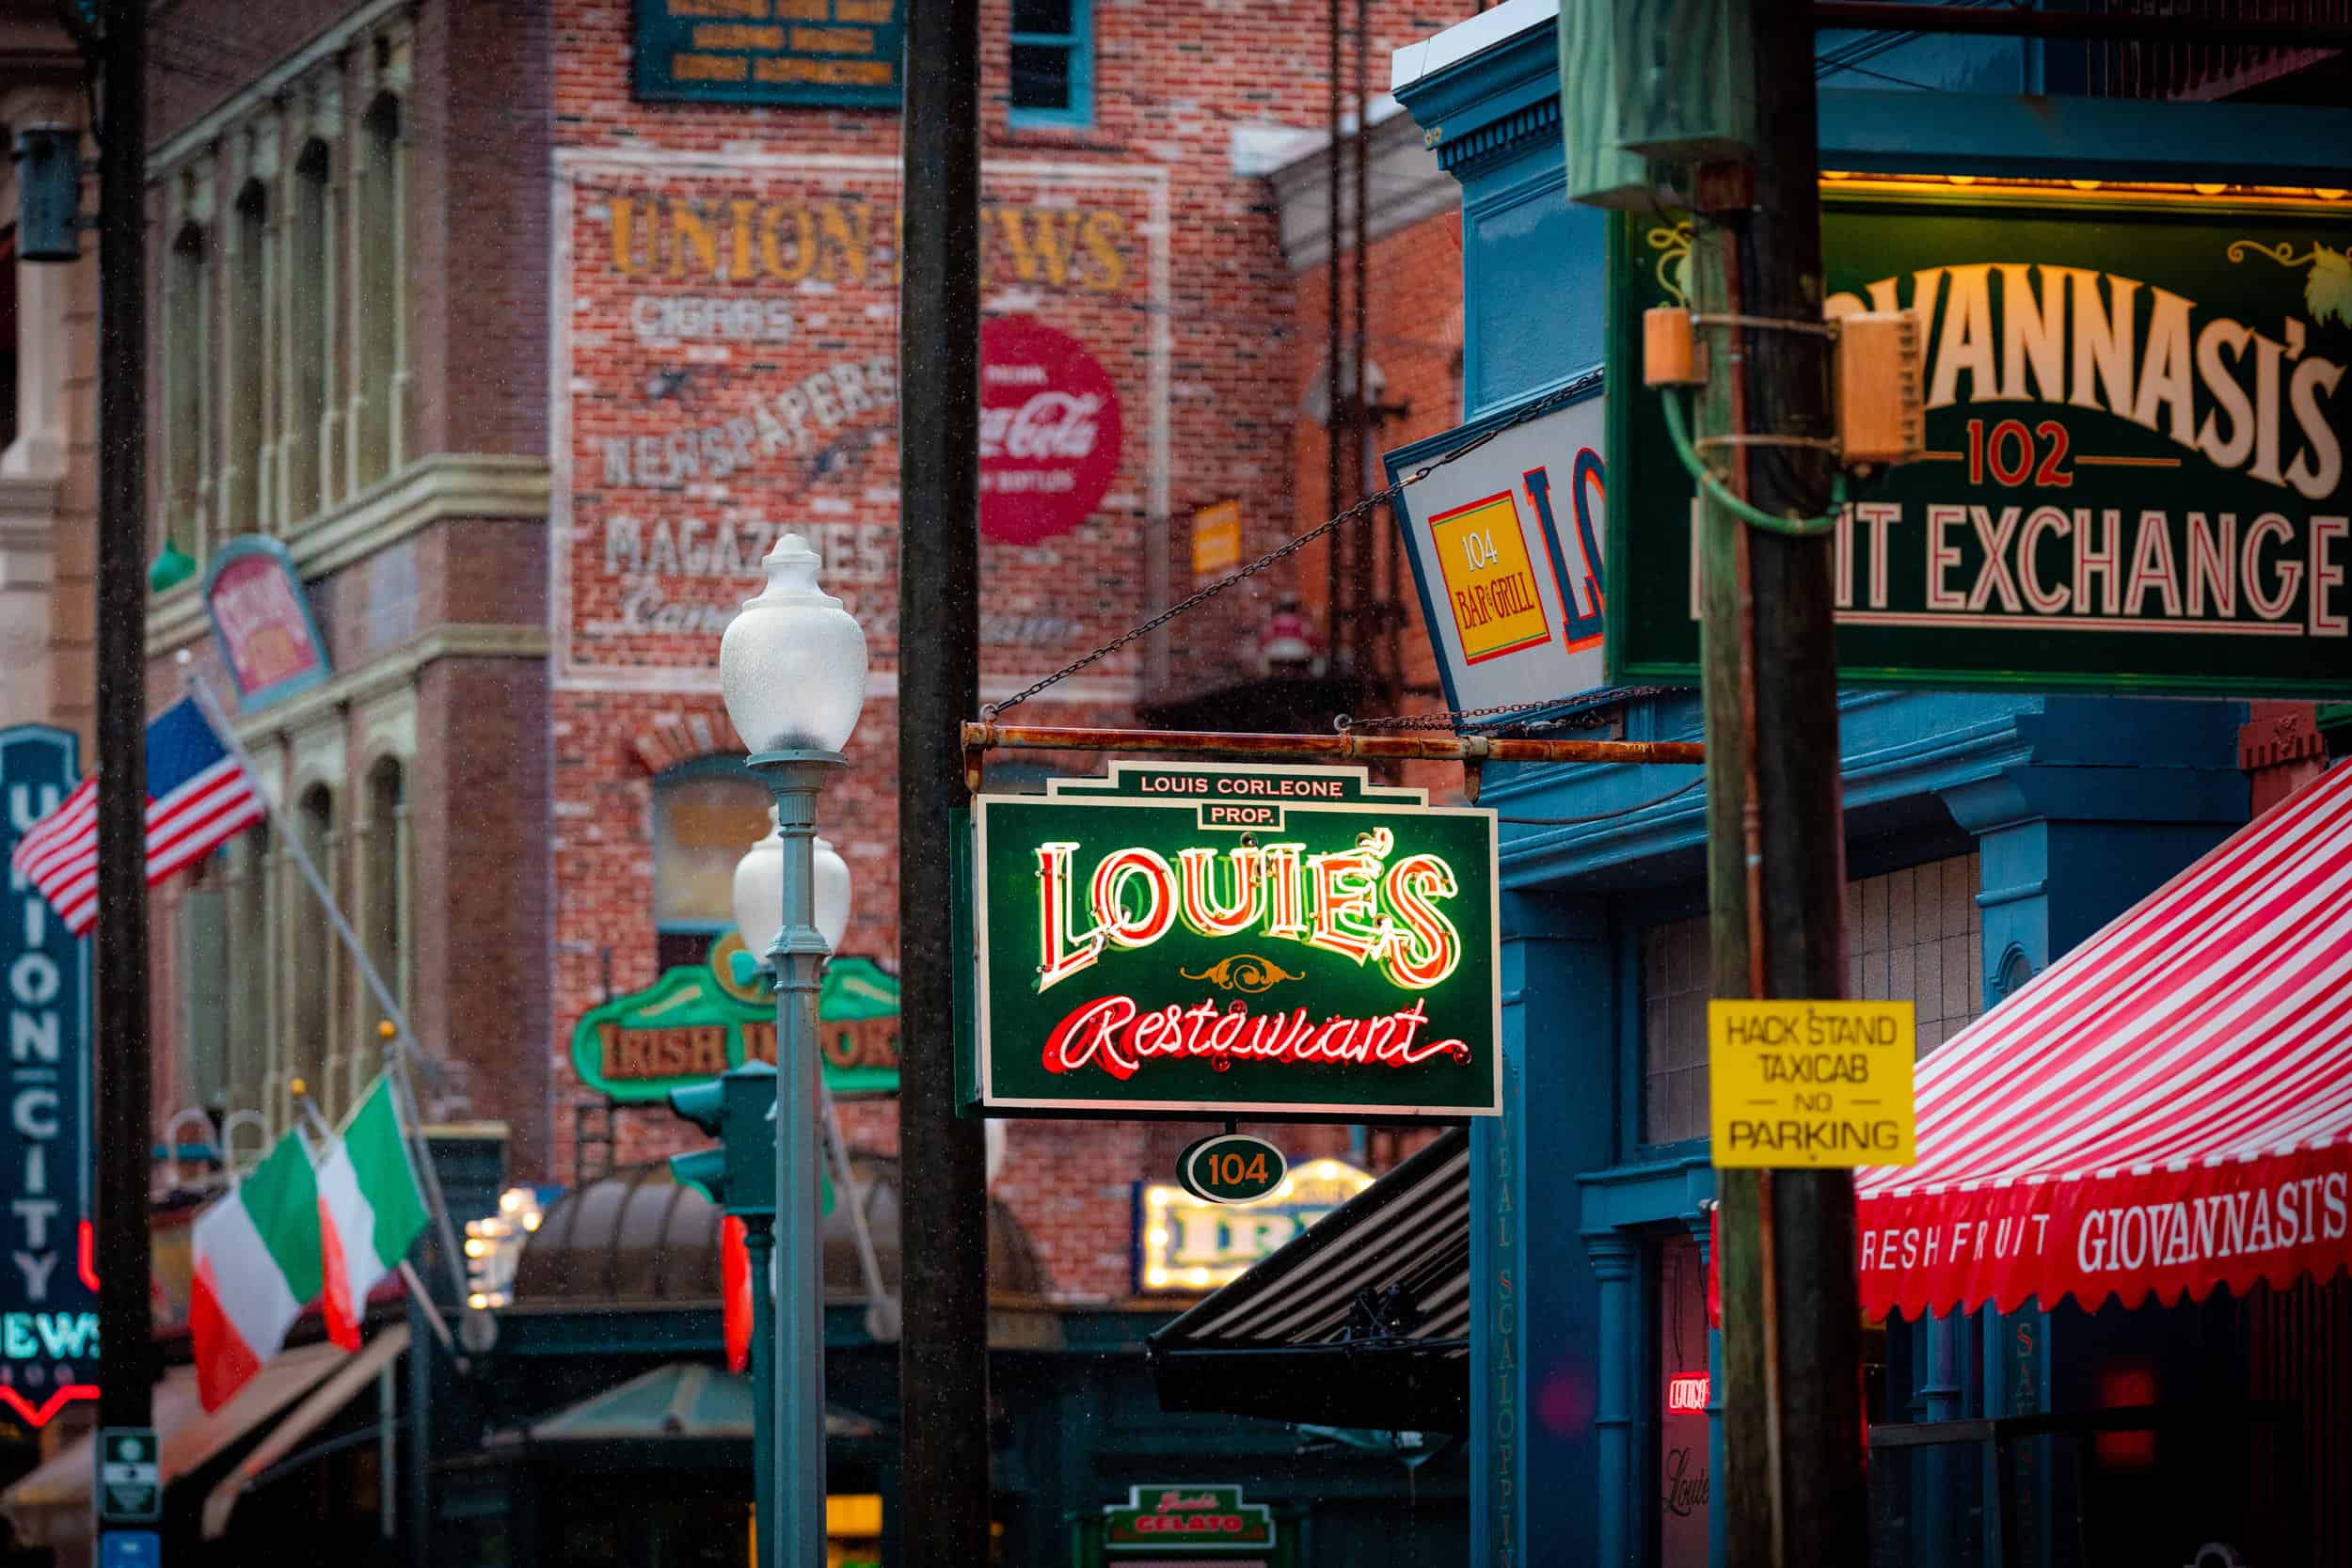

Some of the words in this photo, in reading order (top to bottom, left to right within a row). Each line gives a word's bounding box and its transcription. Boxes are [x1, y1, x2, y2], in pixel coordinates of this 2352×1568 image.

[610, 198, 872, 281] UNION
[1823, 262, 2348, 500] VANNASI'S
[602, 355, 900, 485] NEWSPAPERS
[1967, 419, 2073, 487] 102
[604, 515, 887, 581] MAGAZES
[1461, 527, 1498, 572] 104
[1926, 503, 2350, 637] EXCHANGE
[1455, 584, 1493, 629] BAR
[1490, 571, 1534, 619] GRILL
[1140, 776, 1208, 793] LOUIS
[1217, 779, 1343, 798] CORLEONE
[1211, 807, 1275, 824] PROP.
[1034, 826, 1463, 993] LOUIE'S
[597, 1022, 729, 1079] IRISH
[1041, 995, 1472, 1081] Restaurant
[1725, 1015, 1799, 1046] HACK
[1806, 1015, 1898, 1046] STAND
[1757, 1053, 1869, 1084] TAXICAB
[1793, 1092, 1833, 1113] NO
[1728, 1119, 1900, 1150] PARKING
[1208, 1152, 1269, 1185] 104
[1860, 1227, 1942, 1272] RESH
[1948, 1212, 2051, 1268] FRUIT
[2076, 1171, 2349, 1274] GIOVANNASI'S
